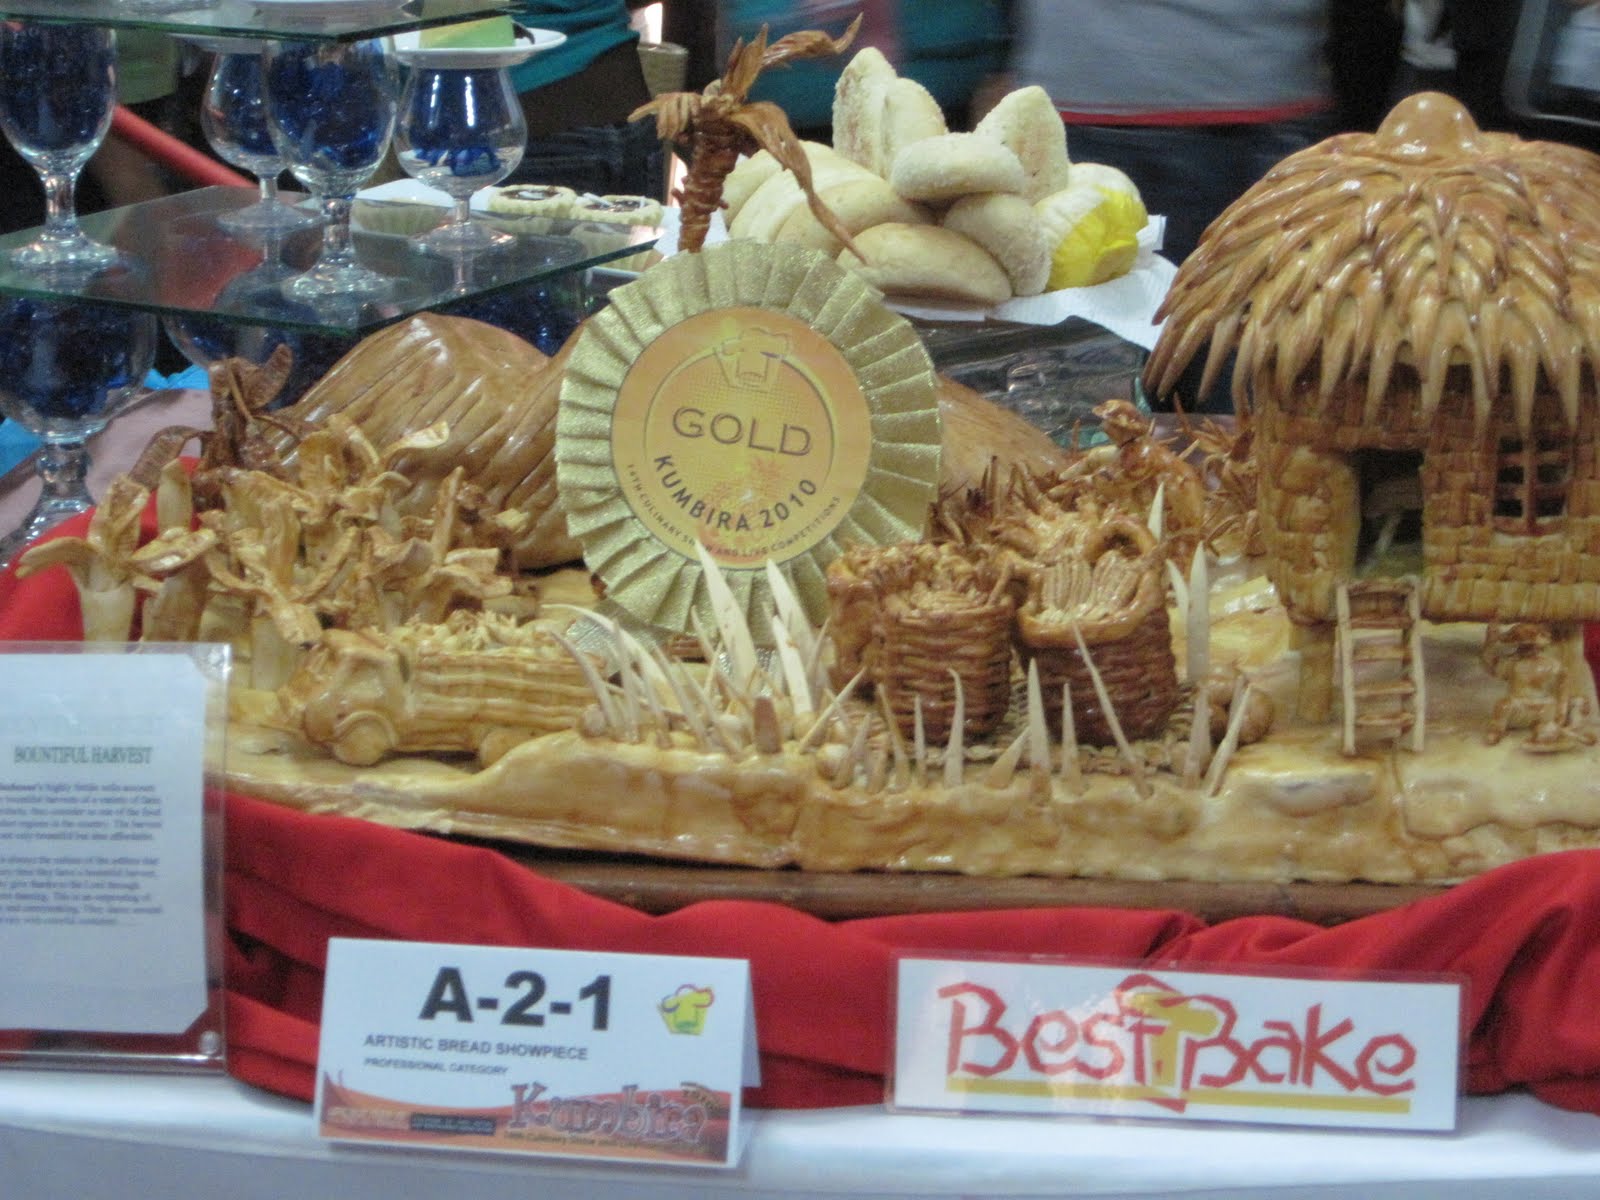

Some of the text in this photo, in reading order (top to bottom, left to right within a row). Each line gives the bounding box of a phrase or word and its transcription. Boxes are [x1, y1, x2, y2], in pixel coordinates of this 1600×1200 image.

[672, 407, 812, 457] GOLD
[653, 455, 817, 532] KUMBIRA 2010
[14, 746, 153, 764] BOUNTIFUL HARVEST
[418, 966, 612, 1031] A-2-1
[363, 1057, 509, 1076] PROFESSIONAL CATEGORY
[364, 1034, 589, 1061] ARTISTIC BREAD SHOWPIECE
